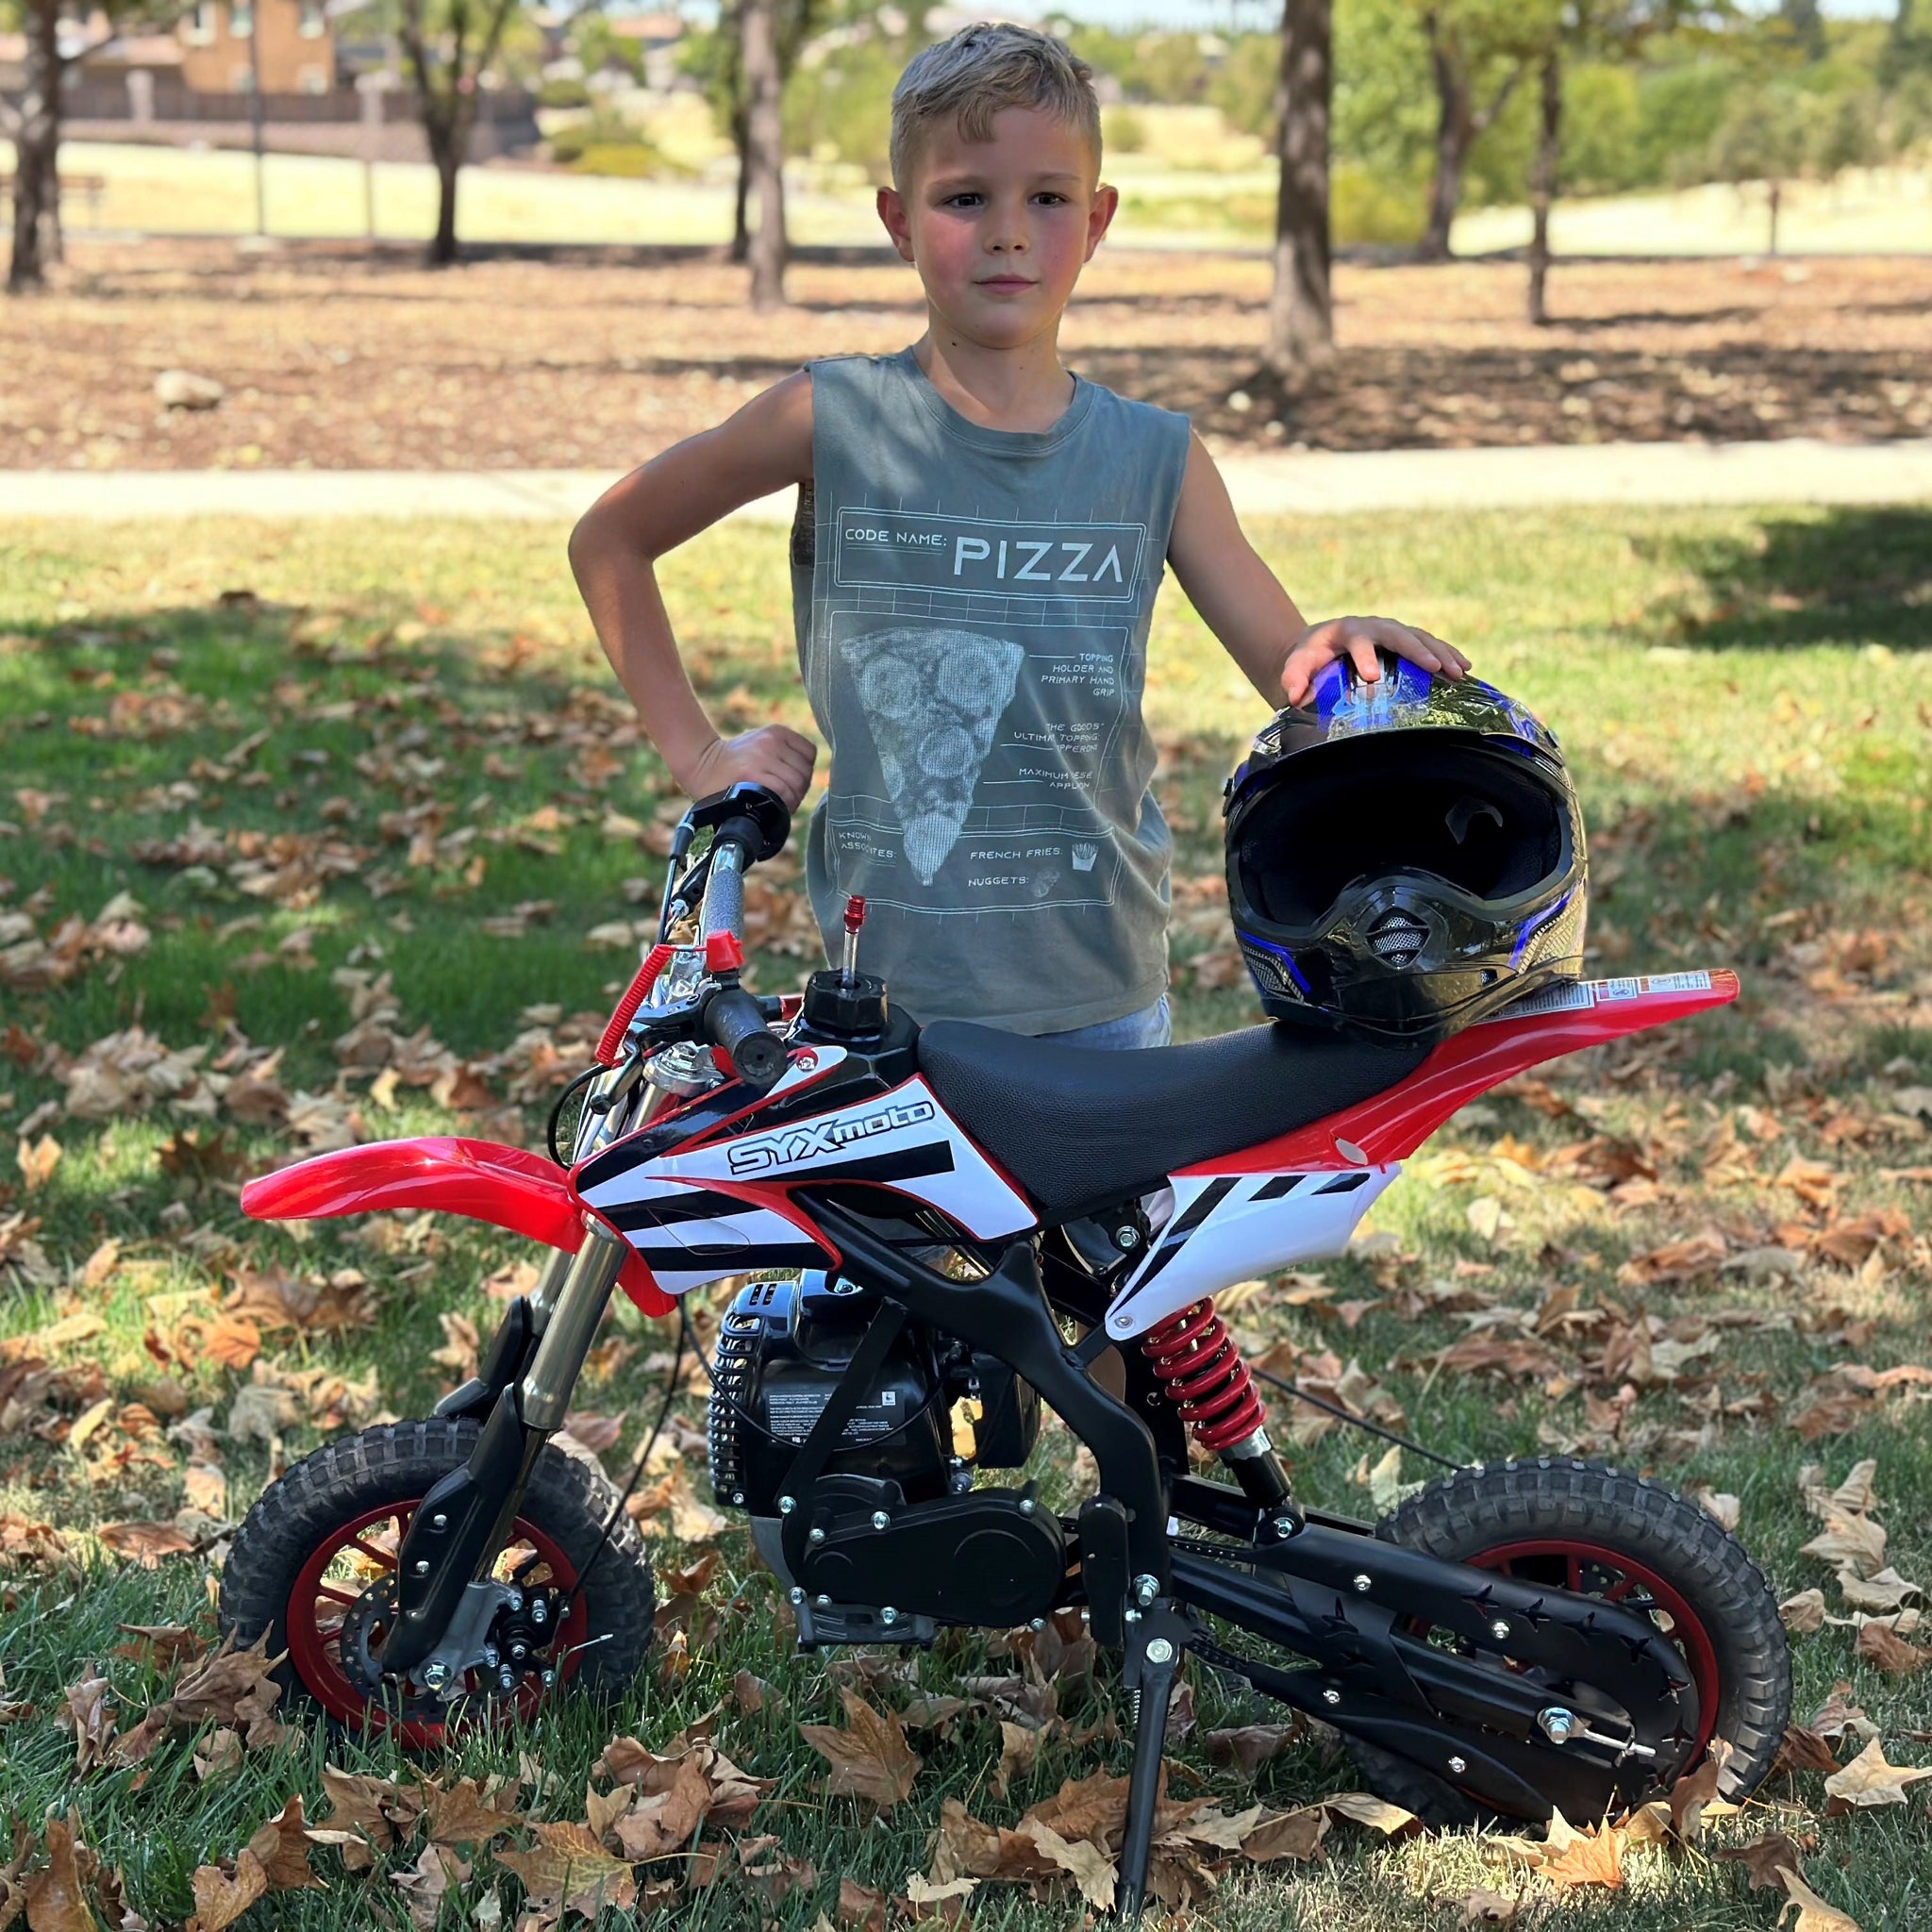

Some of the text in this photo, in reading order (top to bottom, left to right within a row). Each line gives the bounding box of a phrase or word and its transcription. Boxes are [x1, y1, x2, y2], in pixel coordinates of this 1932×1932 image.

[844, 528, 1124, 583] CODE NAME: PIZZA
[1053, 664, 1114, 675] HOLDER AND
[1041, 675, 1115, 686] PRIMARY HAND
[1092, 688, 1115, 697] GRIP
[970, 851, 1021, 860] FRENCH
[968, 875, 1029, 888] NUGGETS:
